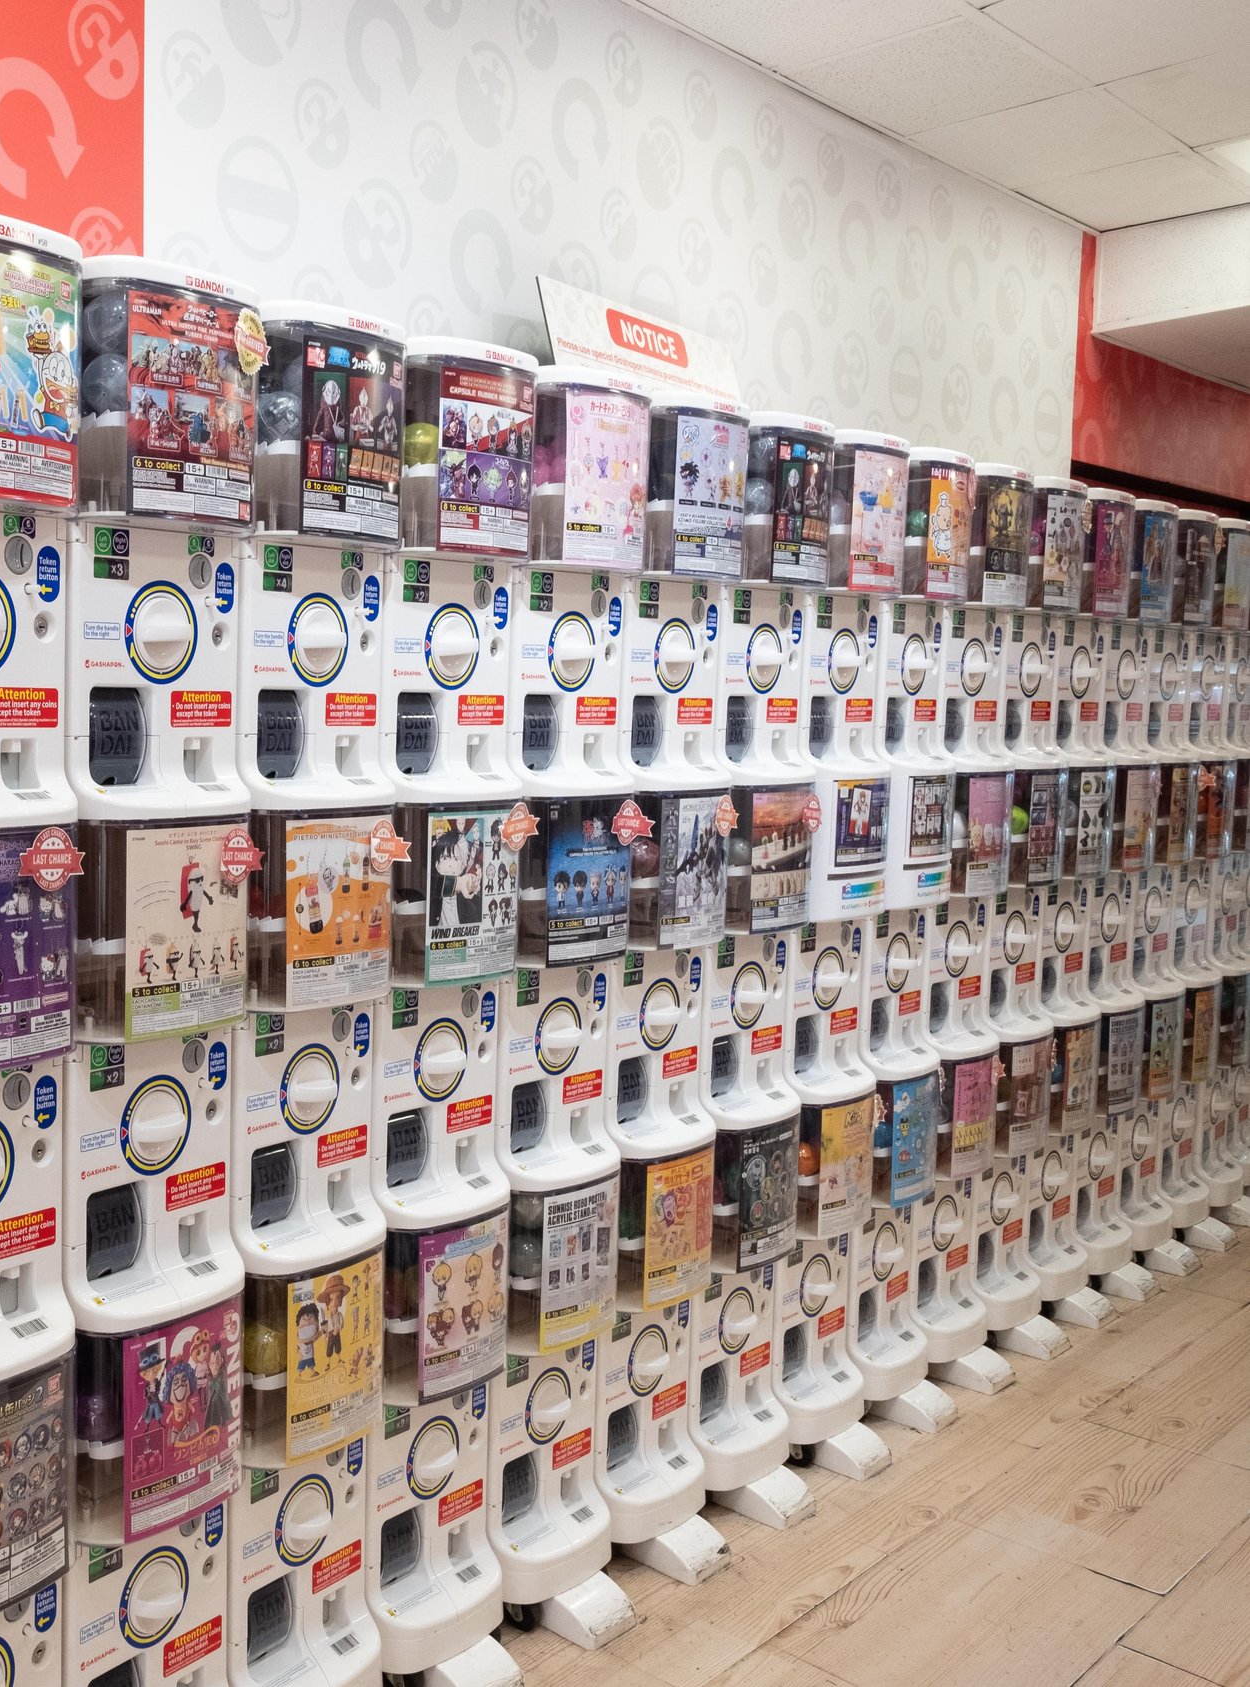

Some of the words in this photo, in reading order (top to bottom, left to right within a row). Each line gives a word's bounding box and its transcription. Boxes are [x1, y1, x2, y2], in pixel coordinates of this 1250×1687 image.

[195, 281, 224, 294] BANDAI
[132, 305, 161, 315] ULTRAMAN
[620, 319, 678, 360] NOTICE
[557, 337, 578, 350] Please
[592, 349, 614, 363] special
[33, 855, 47, 864] LAST
[49, 854, 71, 864] CHANCE
[431, 928, 451, 939] WIND
[452, 926, 479, 937] BREAKER
[548, 1201, 572, 1215] SUNRISE
[574, 1198, 587, 1209] ROBO
[589, 1192, 605, 1204] POSTER
[548, 1212, 572, 1226] ACRYLIC
[573, 1207, 590, 1220] STAND
